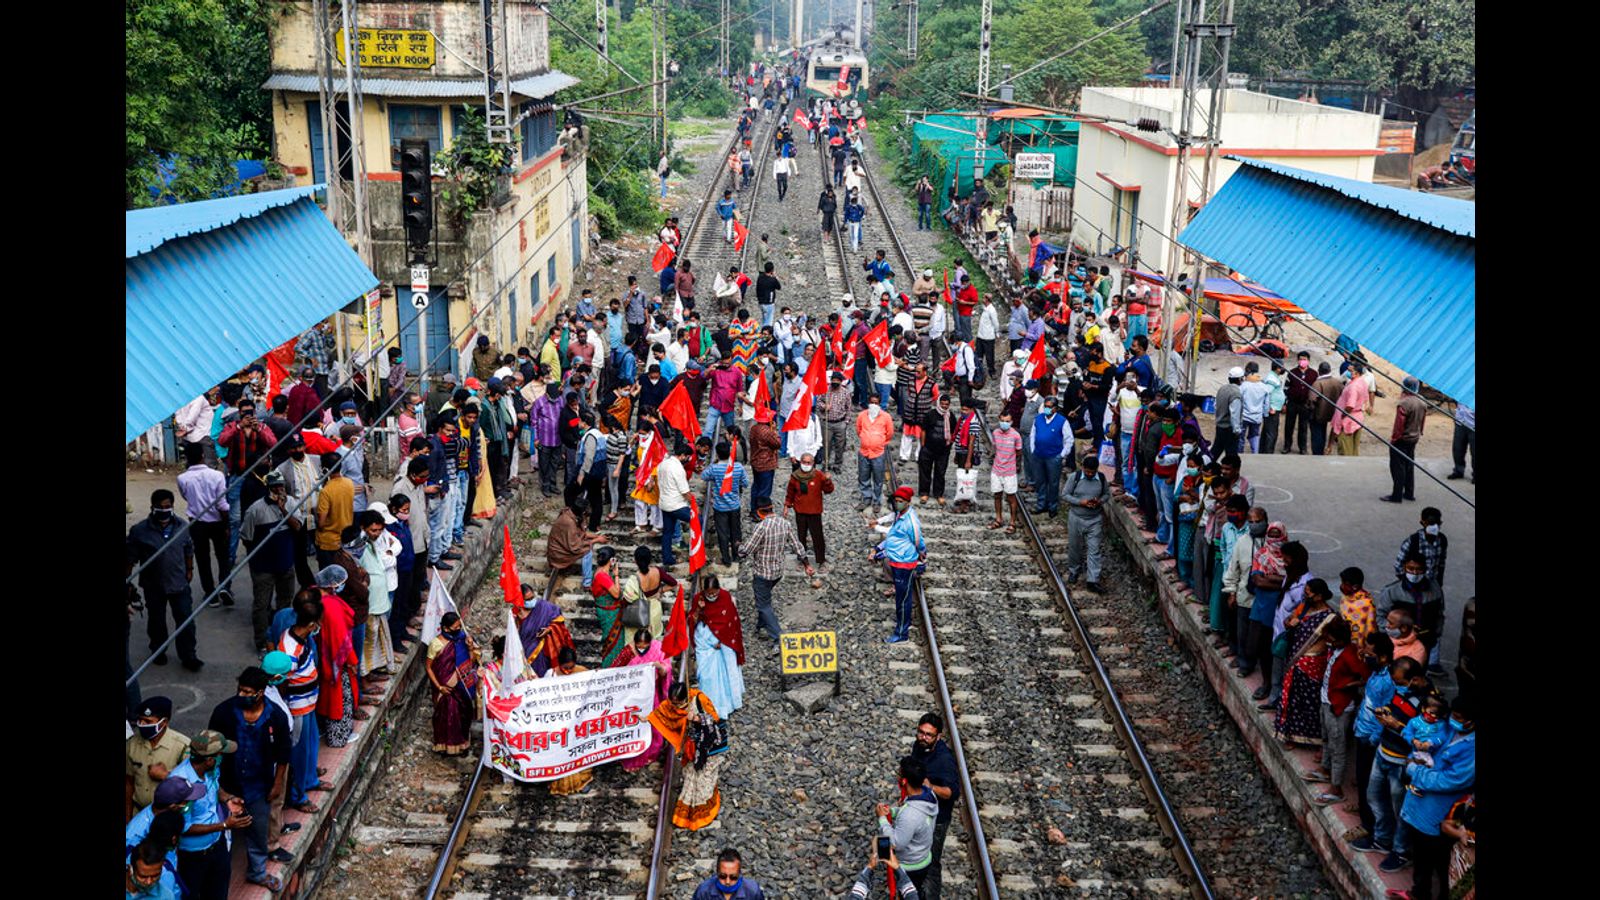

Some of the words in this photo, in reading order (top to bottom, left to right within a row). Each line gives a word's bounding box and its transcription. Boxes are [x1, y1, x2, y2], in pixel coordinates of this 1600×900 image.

[372, 55, 401, 64] RELAY
[404, 56, 429, 64] ROOM
[415, 295, 425, 306] A
[786, 635, 830, 650] EMU
[786, 653, 834, 669] STOP
[512, 708, 531, 727] ২৬
[535, 709, 572, 724] নভেম্বর
[574, 706, 642, 739] ধর্মঘট
[568, 739, 597, 758] সফল
[528, 768, 545, 777] SFI
[554, 762, 575, 774] DYFI
[581, 750, 611, 765] AIDWA
[617, 742, 641, 754] CITU
